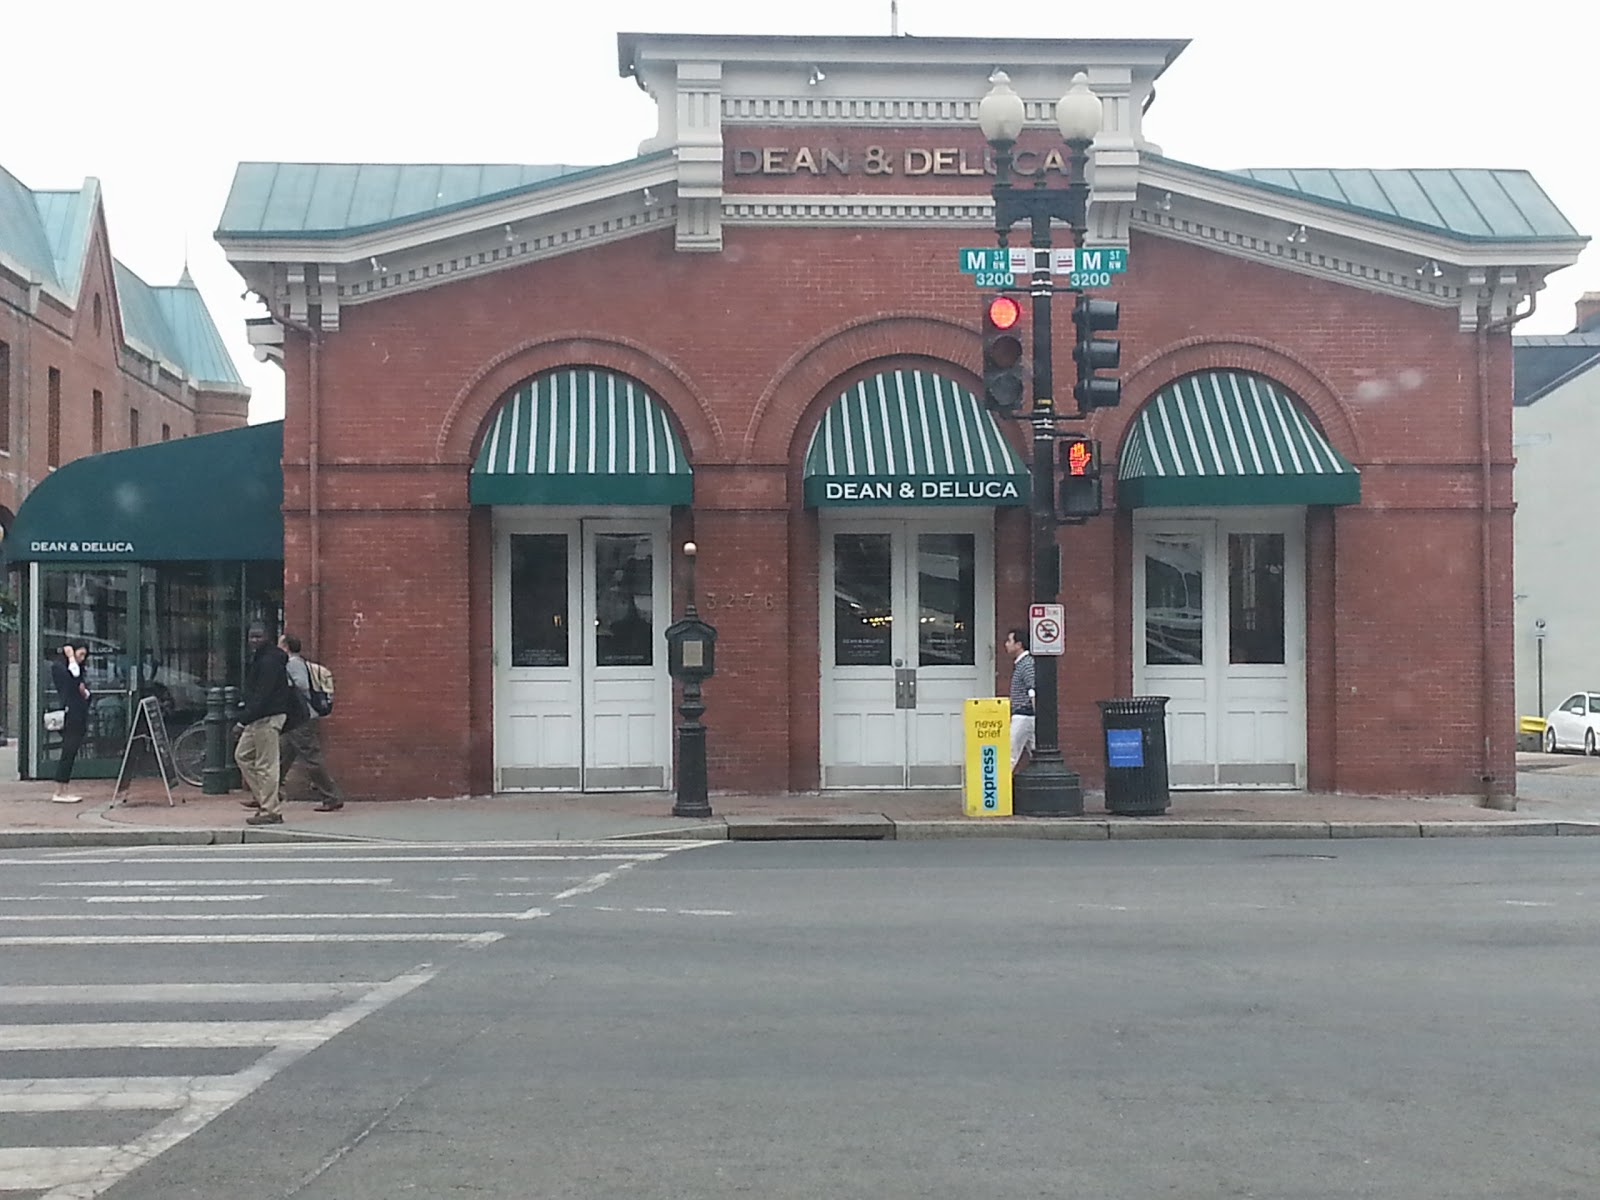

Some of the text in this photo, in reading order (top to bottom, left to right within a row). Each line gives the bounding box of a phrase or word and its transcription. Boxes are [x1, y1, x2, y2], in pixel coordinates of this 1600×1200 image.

[734, 147, 850, 175] DEAN
[865, 145, 893, 175] &
[967, 251, 1004, 270] M ST
[1082, 251, 1120, 271] M ST
[976, 273, 1014, 286] 3200
[1071, 273, 1110, 287] 3200
[826, 481, 1019, 499] DEAN & DELUCA
[31, 542, 134, 553] DEAN & DELUCA
[706, 592, 774, 610] 3276
[975, 720, 1003, 729] news
[977, 728, 1001, 739] brief
[983, 747, 997, 809] express
